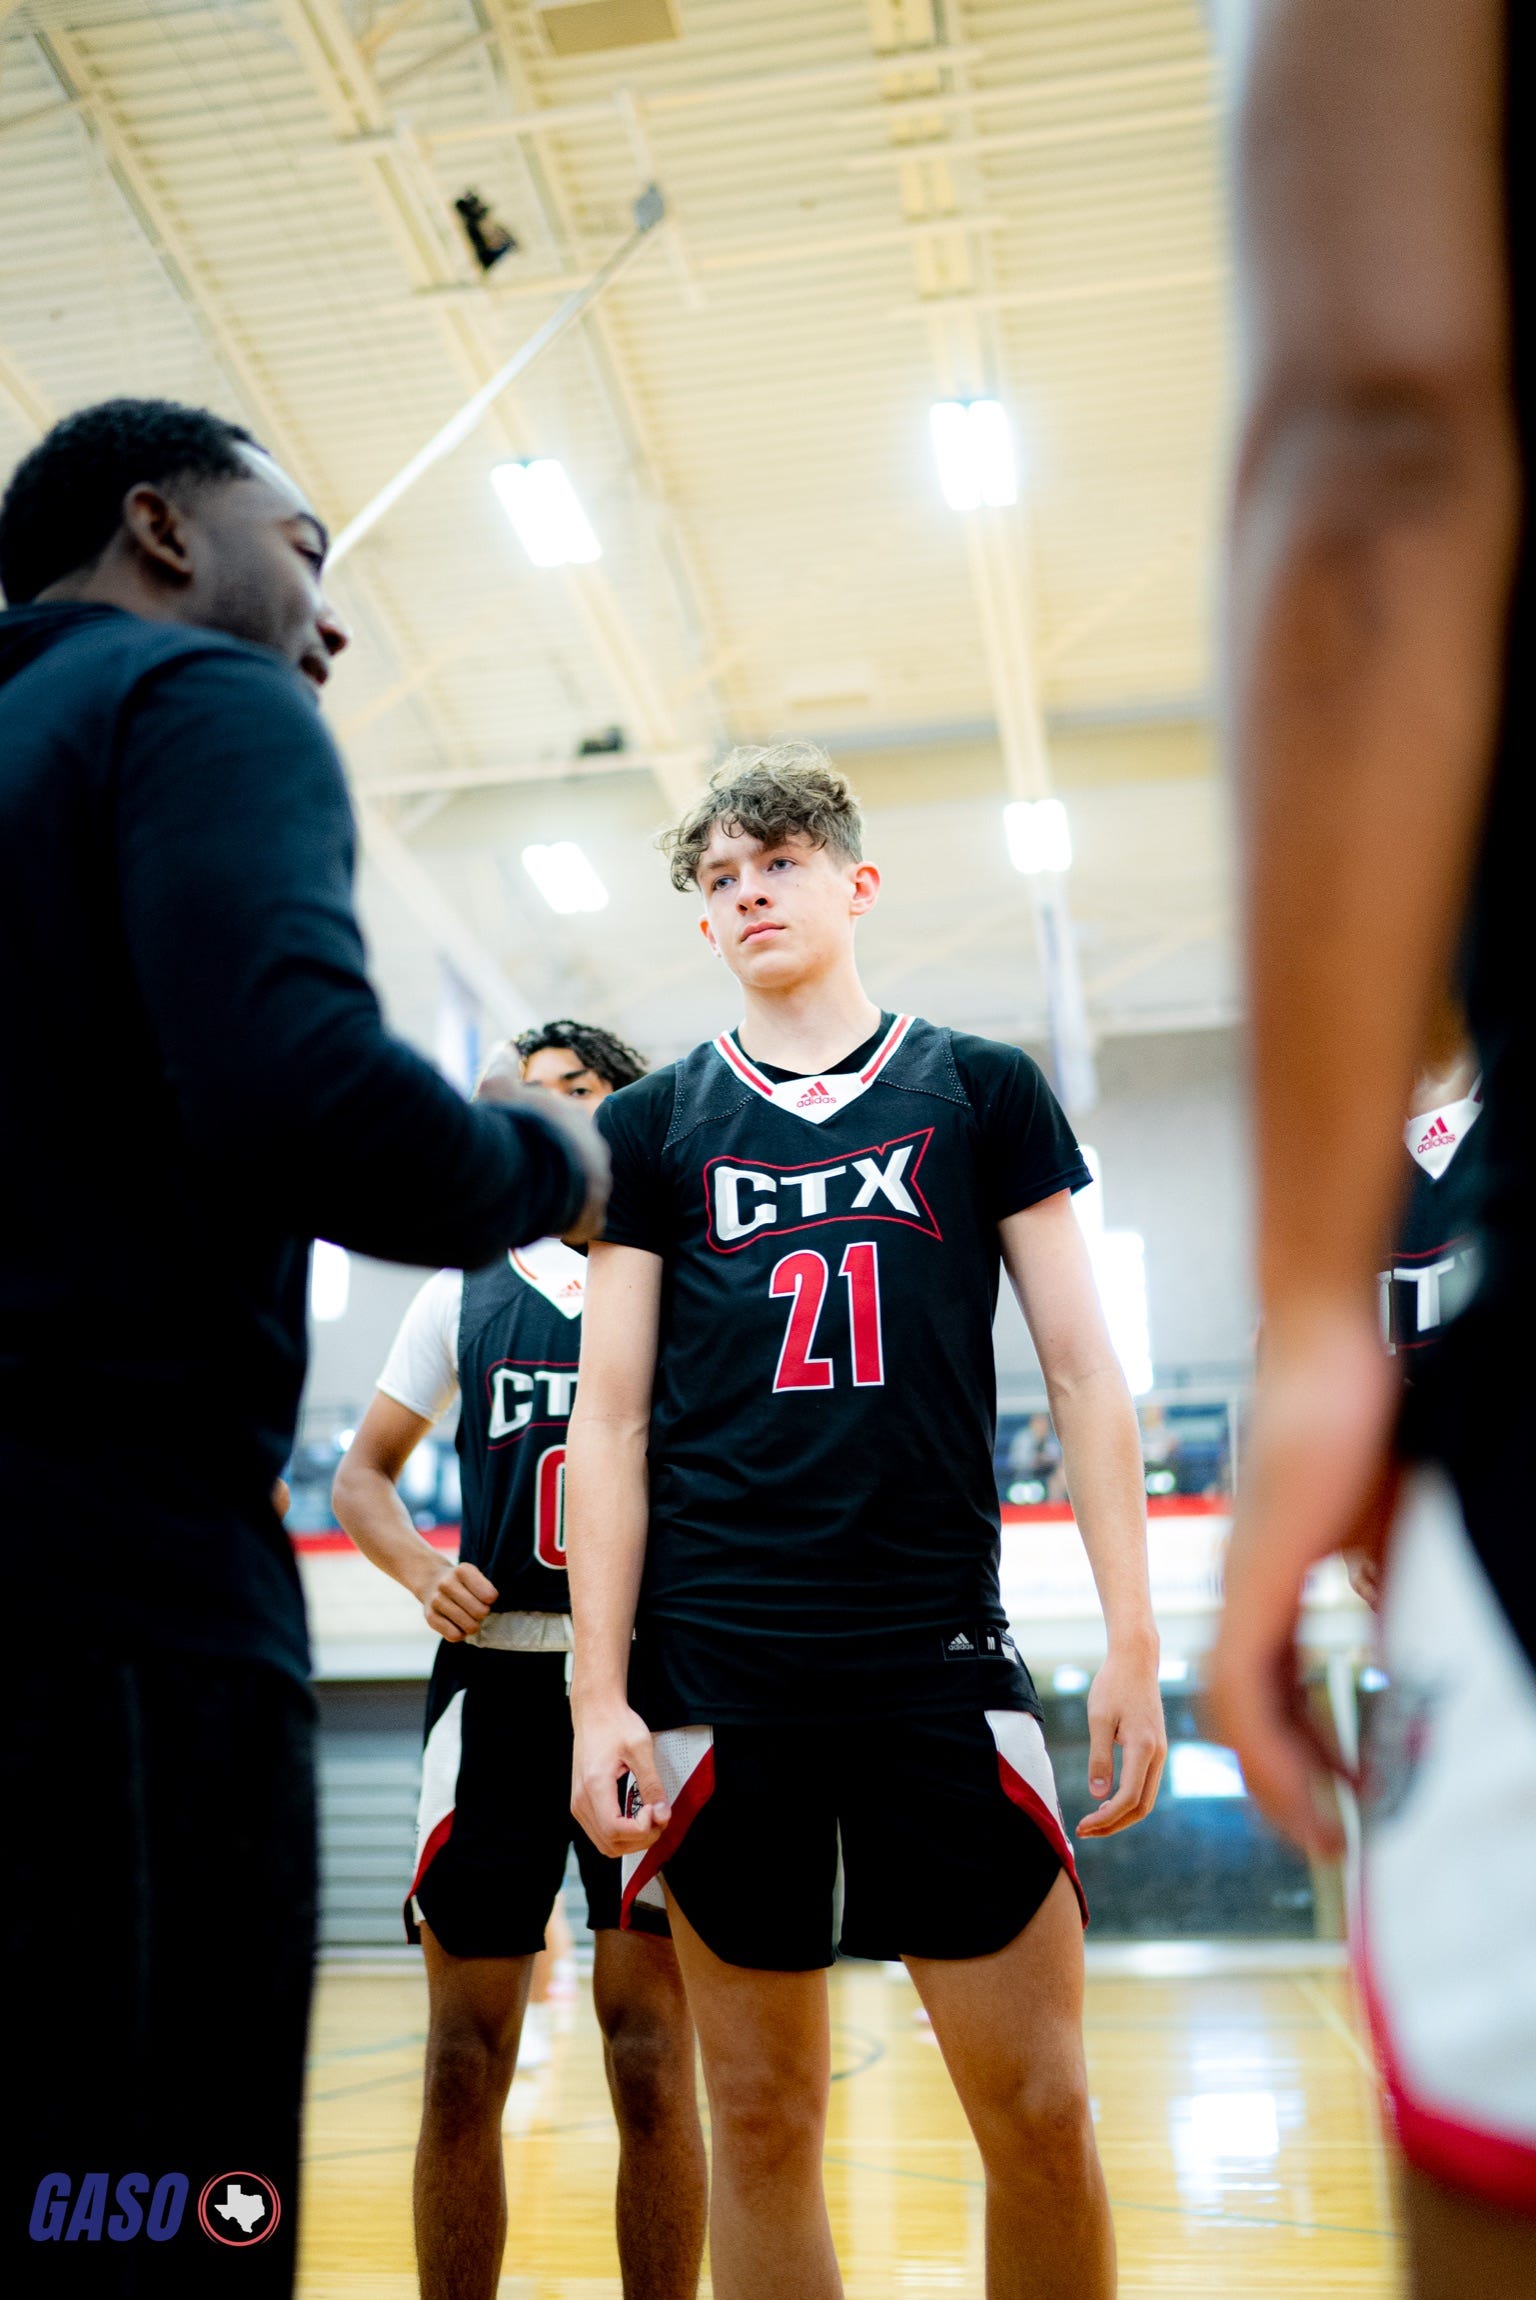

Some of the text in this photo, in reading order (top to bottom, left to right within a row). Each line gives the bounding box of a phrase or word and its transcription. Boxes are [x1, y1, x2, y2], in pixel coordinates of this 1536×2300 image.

[796, 1095, 838, 1108] adidas
[714, 1145, 921, 1241] CTX
[769, 1241, 885, 1394] 21
[488, 1367, 578, 1440] CT
